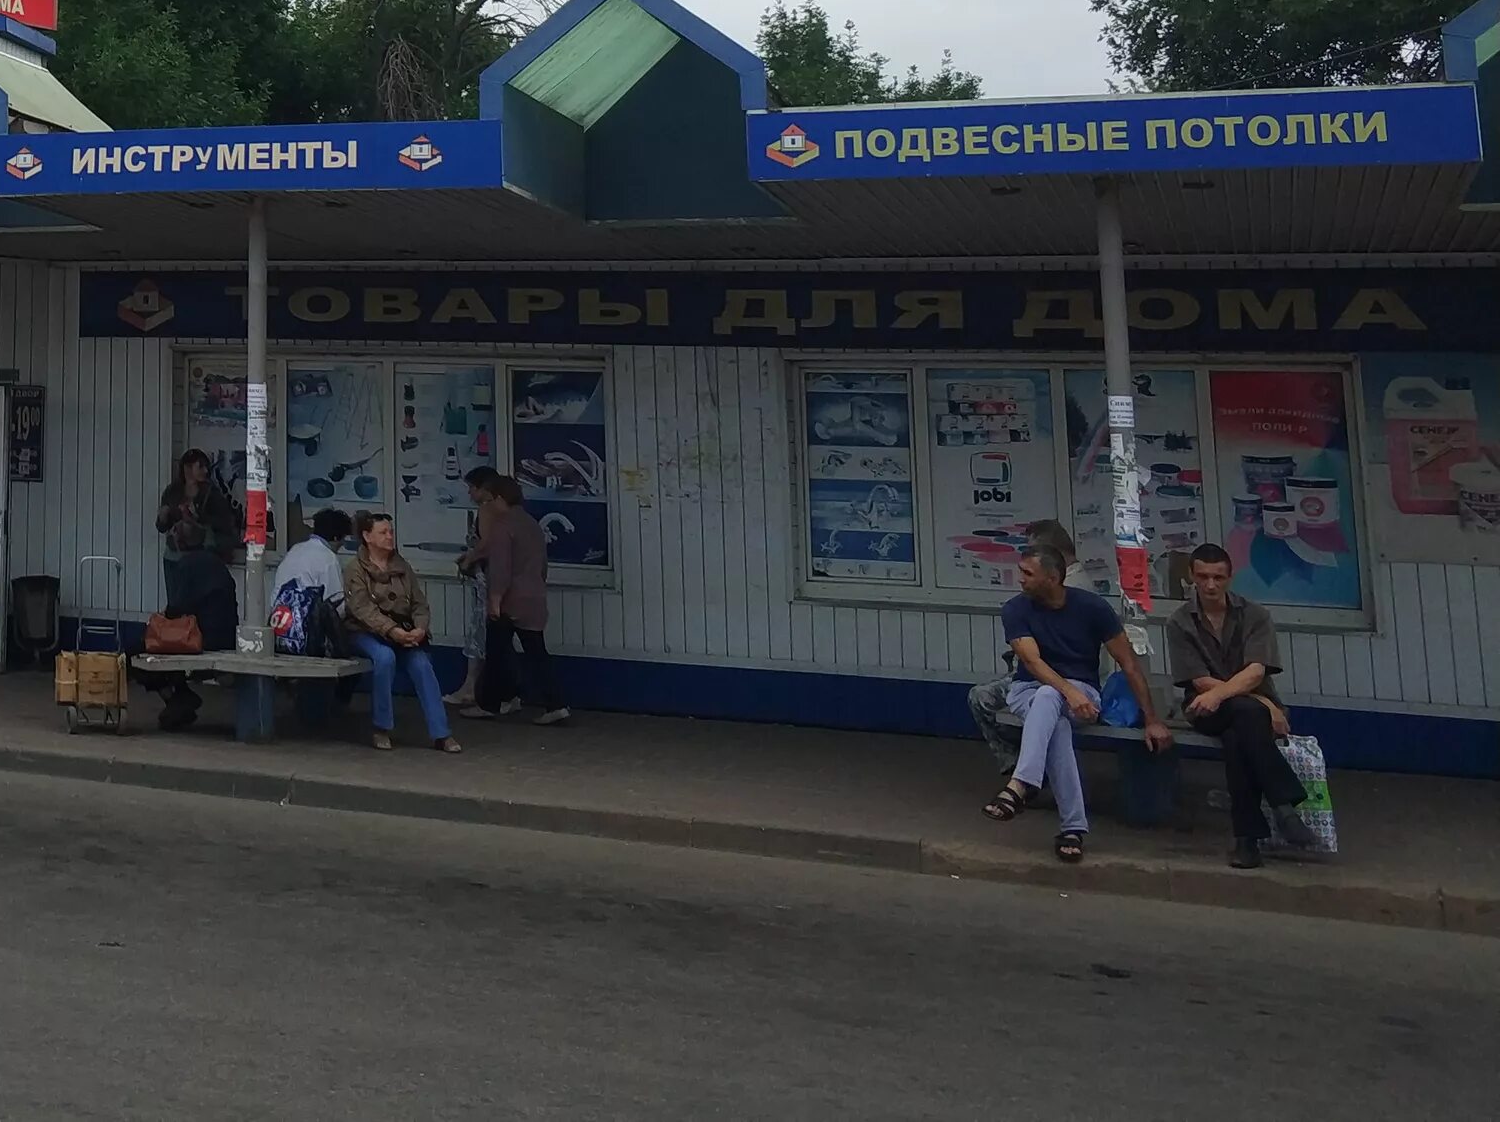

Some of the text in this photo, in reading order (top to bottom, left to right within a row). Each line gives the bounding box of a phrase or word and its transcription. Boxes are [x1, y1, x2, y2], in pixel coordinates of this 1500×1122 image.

[72, 141, 357, 175] ИНСТРУМЕНТЫ
[834, 111, 1389, 163] ПОДВЕСНЫЕ ПОТОЛКИ
[225, 286, 1428, 337] ТОВАРЫ ДЛЯ ДОМА
